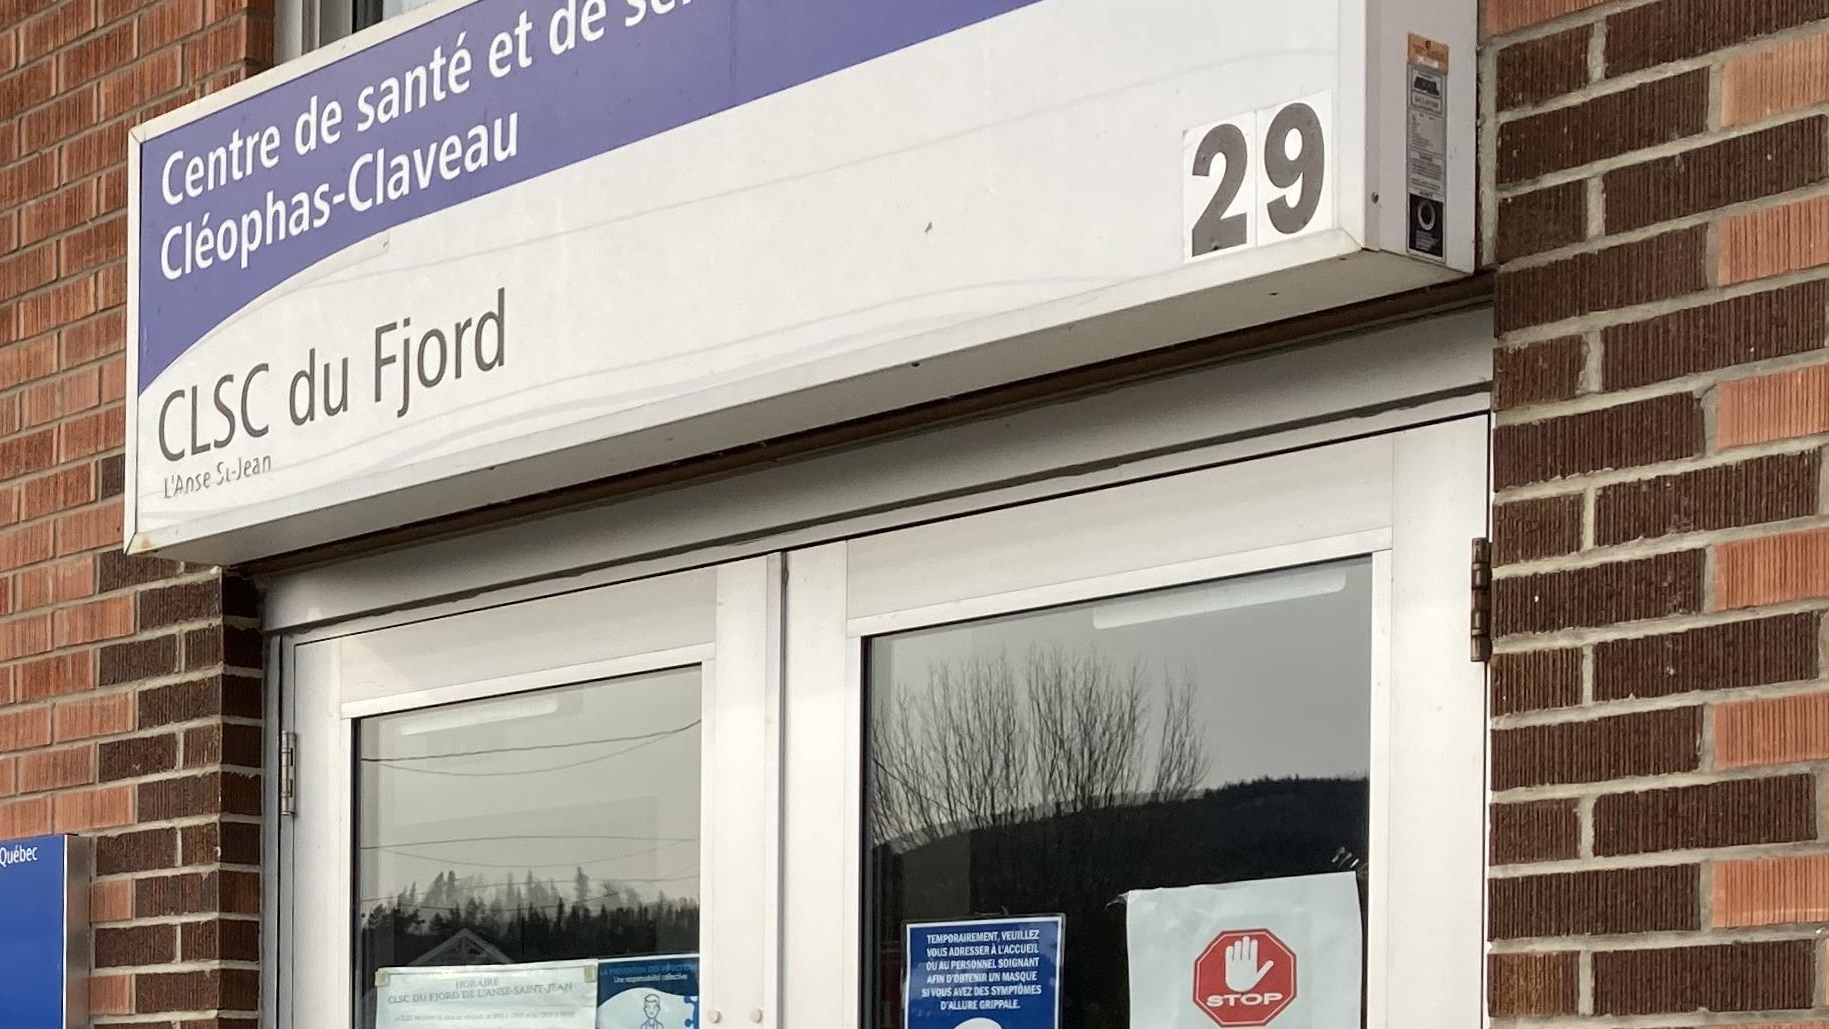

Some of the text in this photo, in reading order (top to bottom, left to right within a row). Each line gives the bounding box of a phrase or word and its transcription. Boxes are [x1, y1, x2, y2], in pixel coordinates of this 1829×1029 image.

[161, 0, 607, 206] Centre de santé et de
[1192, 102, 1324, 258] 29
[160, 111, 521, 281] Cléophas-Claveau
[159, 288, 506, 462] CLSC du Fjord
[164, 471, 211, 499] L'Anse
[0, 844, 38, 868] Québec
[927, 929, 1040, 944] TEMPORAIREMENT, VEUILLEZ
[927, 943, 1039, 957] VOUS ADRESSER À L'ACCUEIL
[926, 957, 1039, 971] OU AU PERSONNEL SOIGNANT
[927, 971, 1037, 984] AFIN D'OBTENIR UN MASQUE
[922, 983, 1042, 997] SI VOUS AVEZ DES SYMPTÔMES
[941, 998, 1021, 1010] D'ALLURE GRIPPALE.
[1206, 992, 1283, 1007] STOP
